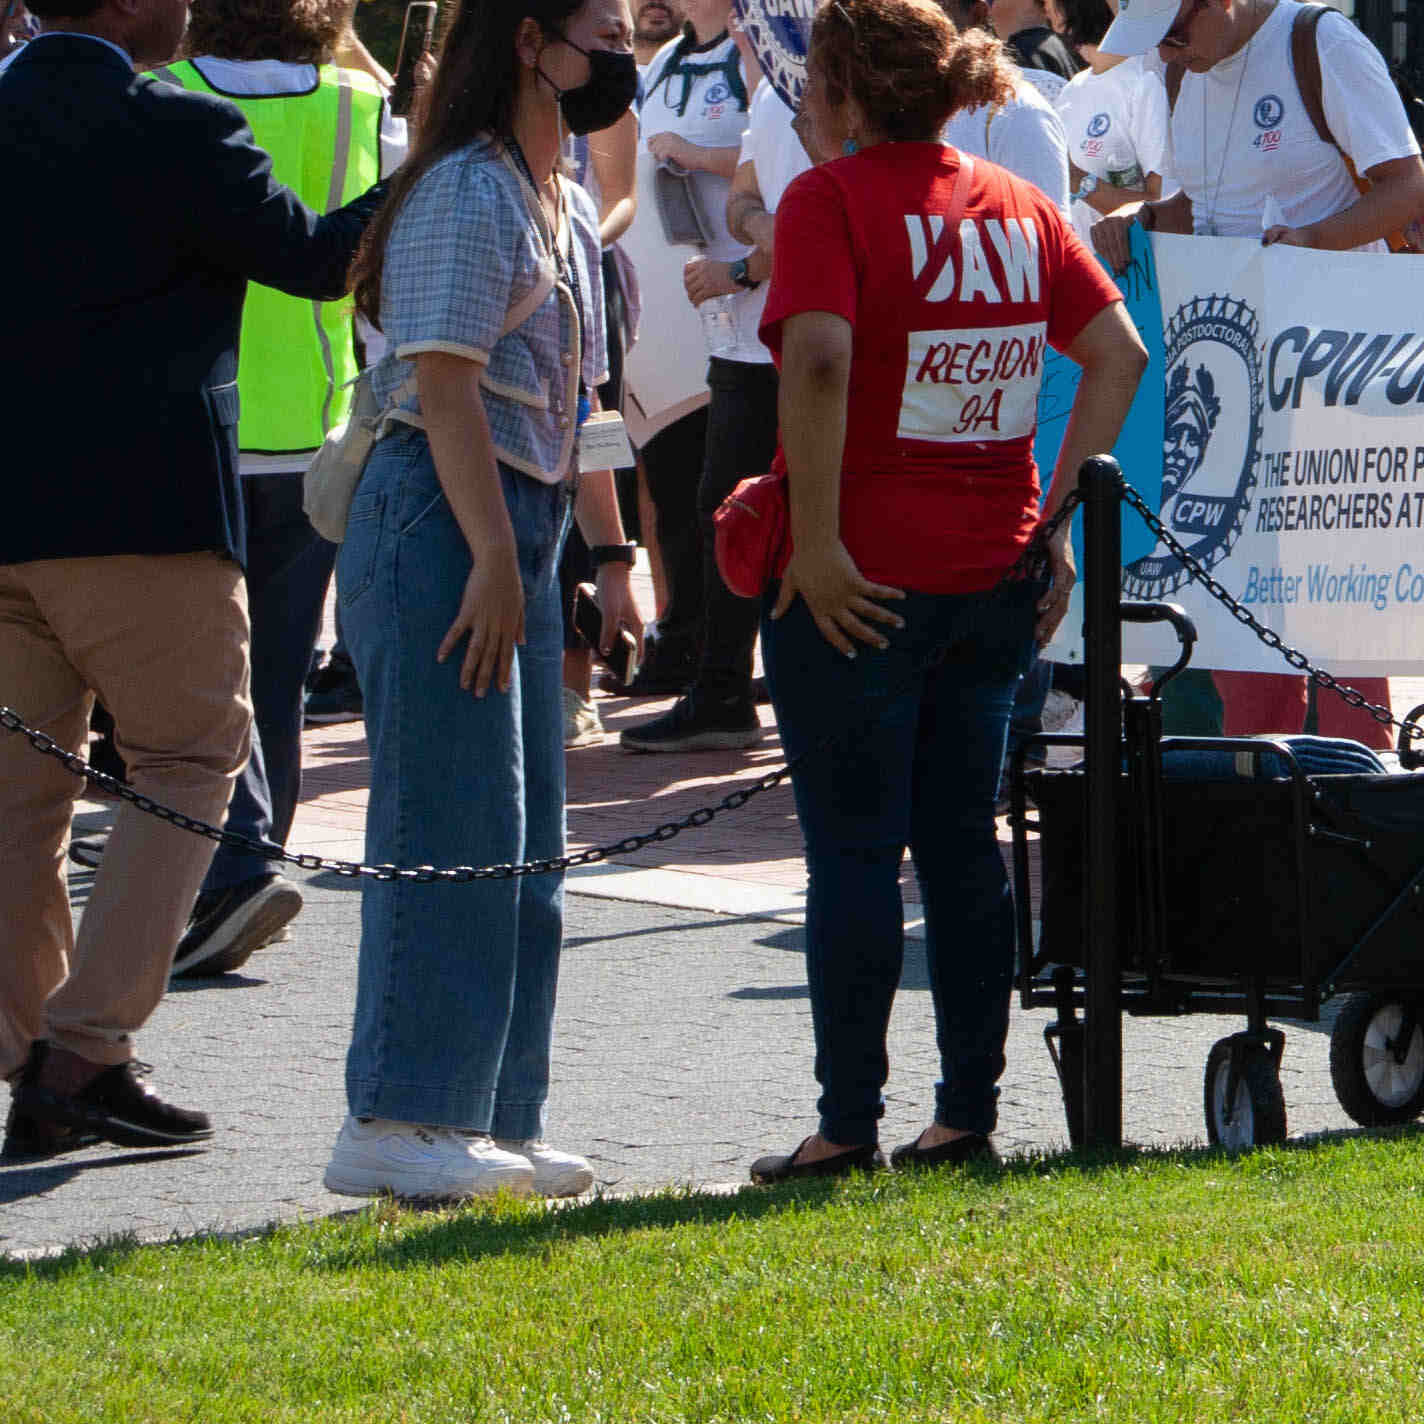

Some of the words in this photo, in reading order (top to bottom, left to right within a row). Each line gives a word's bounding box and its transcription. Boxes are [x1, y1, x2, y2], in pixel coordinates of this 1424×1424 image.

[915, 335, 1043, 384] REGION
[1264, 451, 1292, 488] THE
[1294, 448, 1360, 485] UNION
[1363, 446, 1409, 483] FOR
[1175, 499, 1226, 527] CPW
[1256, 491, 1393, 532] RESEARCHERS
[1244, 565, 1303, 604] Better
[1307, 562, 1393, 611] Working
